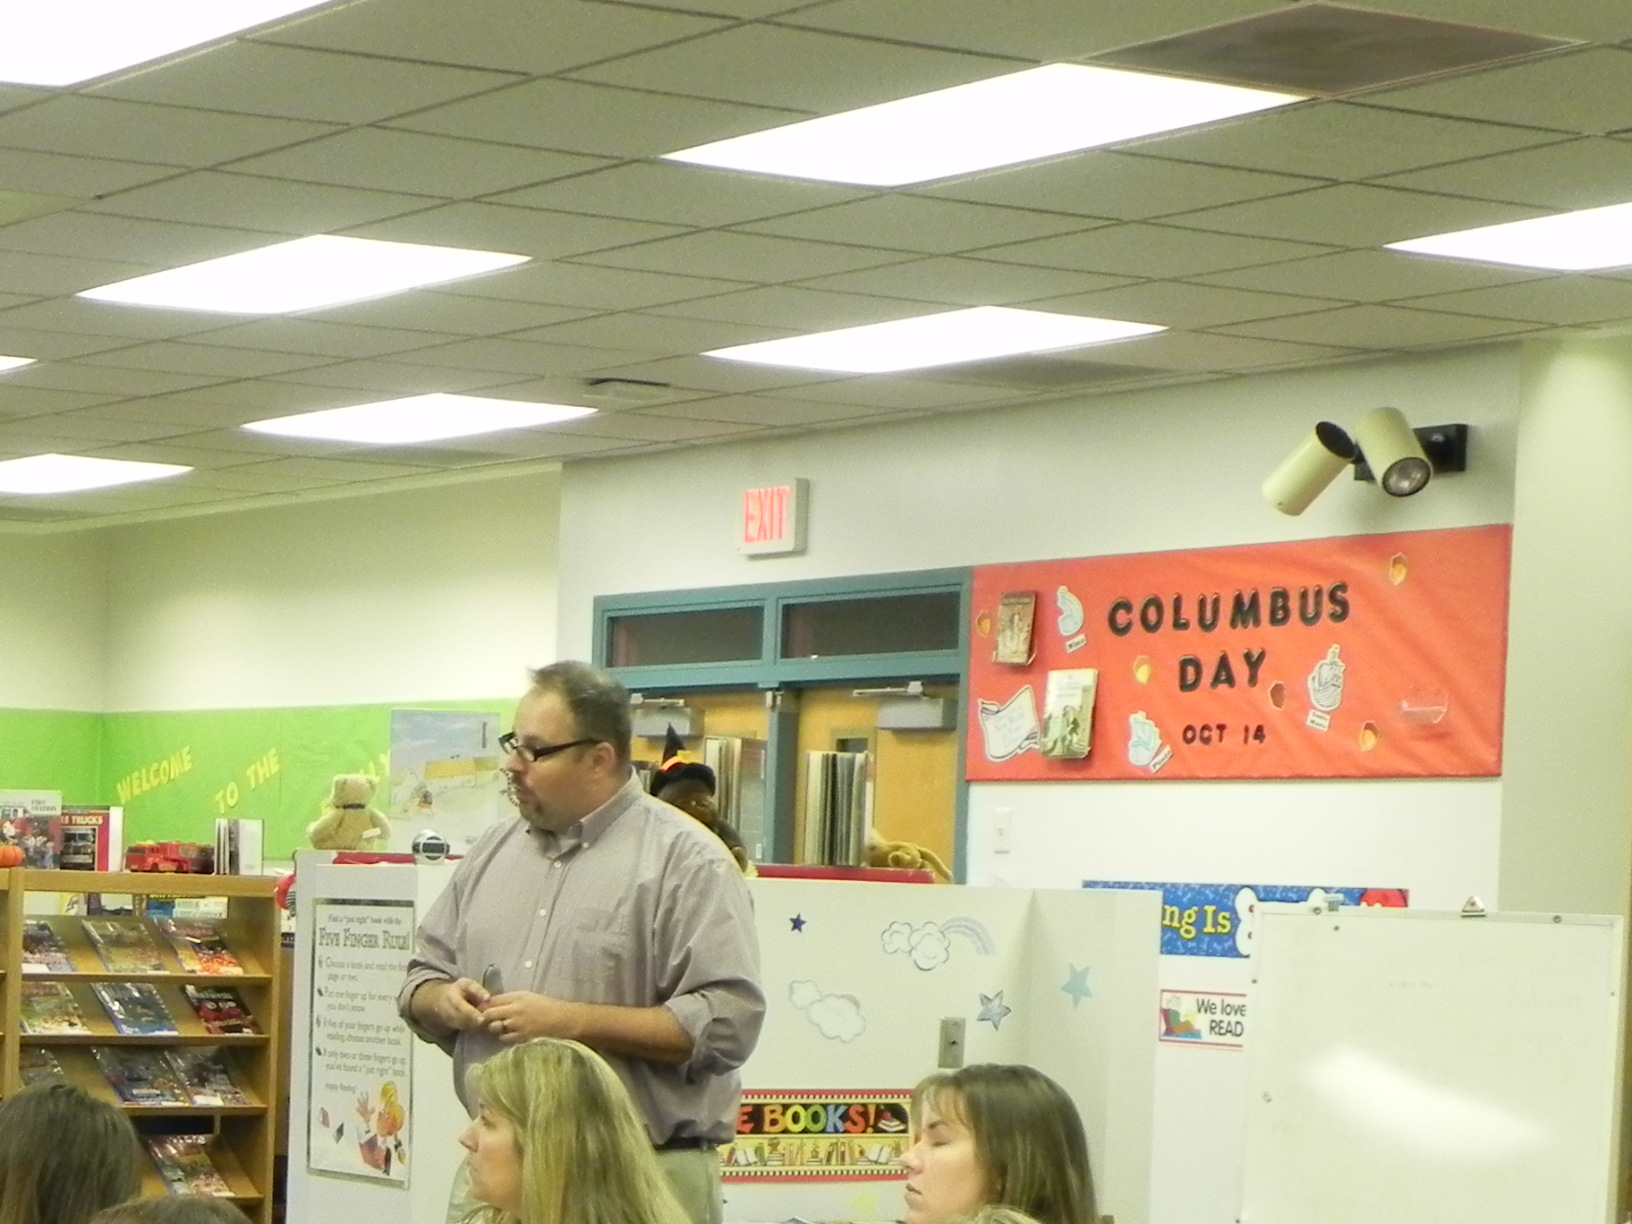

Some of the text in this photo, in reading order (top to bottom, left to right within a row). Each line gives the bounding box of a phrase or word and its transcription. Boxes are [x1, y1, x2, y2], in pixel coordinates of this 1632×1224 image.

[745, 486, 791, 543] EXIT
[1108, 581, 1350, 636] COLUMBUS
[1179, 647, 1266, 693] DAY
[1182, 724, 1267, 745] OCT 14
[116, 746, 193, 805] WELCOME
[216, 782, 239, 814] TO
[246, 747, 280, 790] THE
[72, 815, 104, 825] TRUCKS
[1163, 905, 1232, 939] ng Is
[343, 928, 379, 949] FINGER
[1196, 998, 1247, 1017] We love
[1209, 1018, 1244, 1038] READ
[736, 1103, 877, 1134] E BOOKS!
